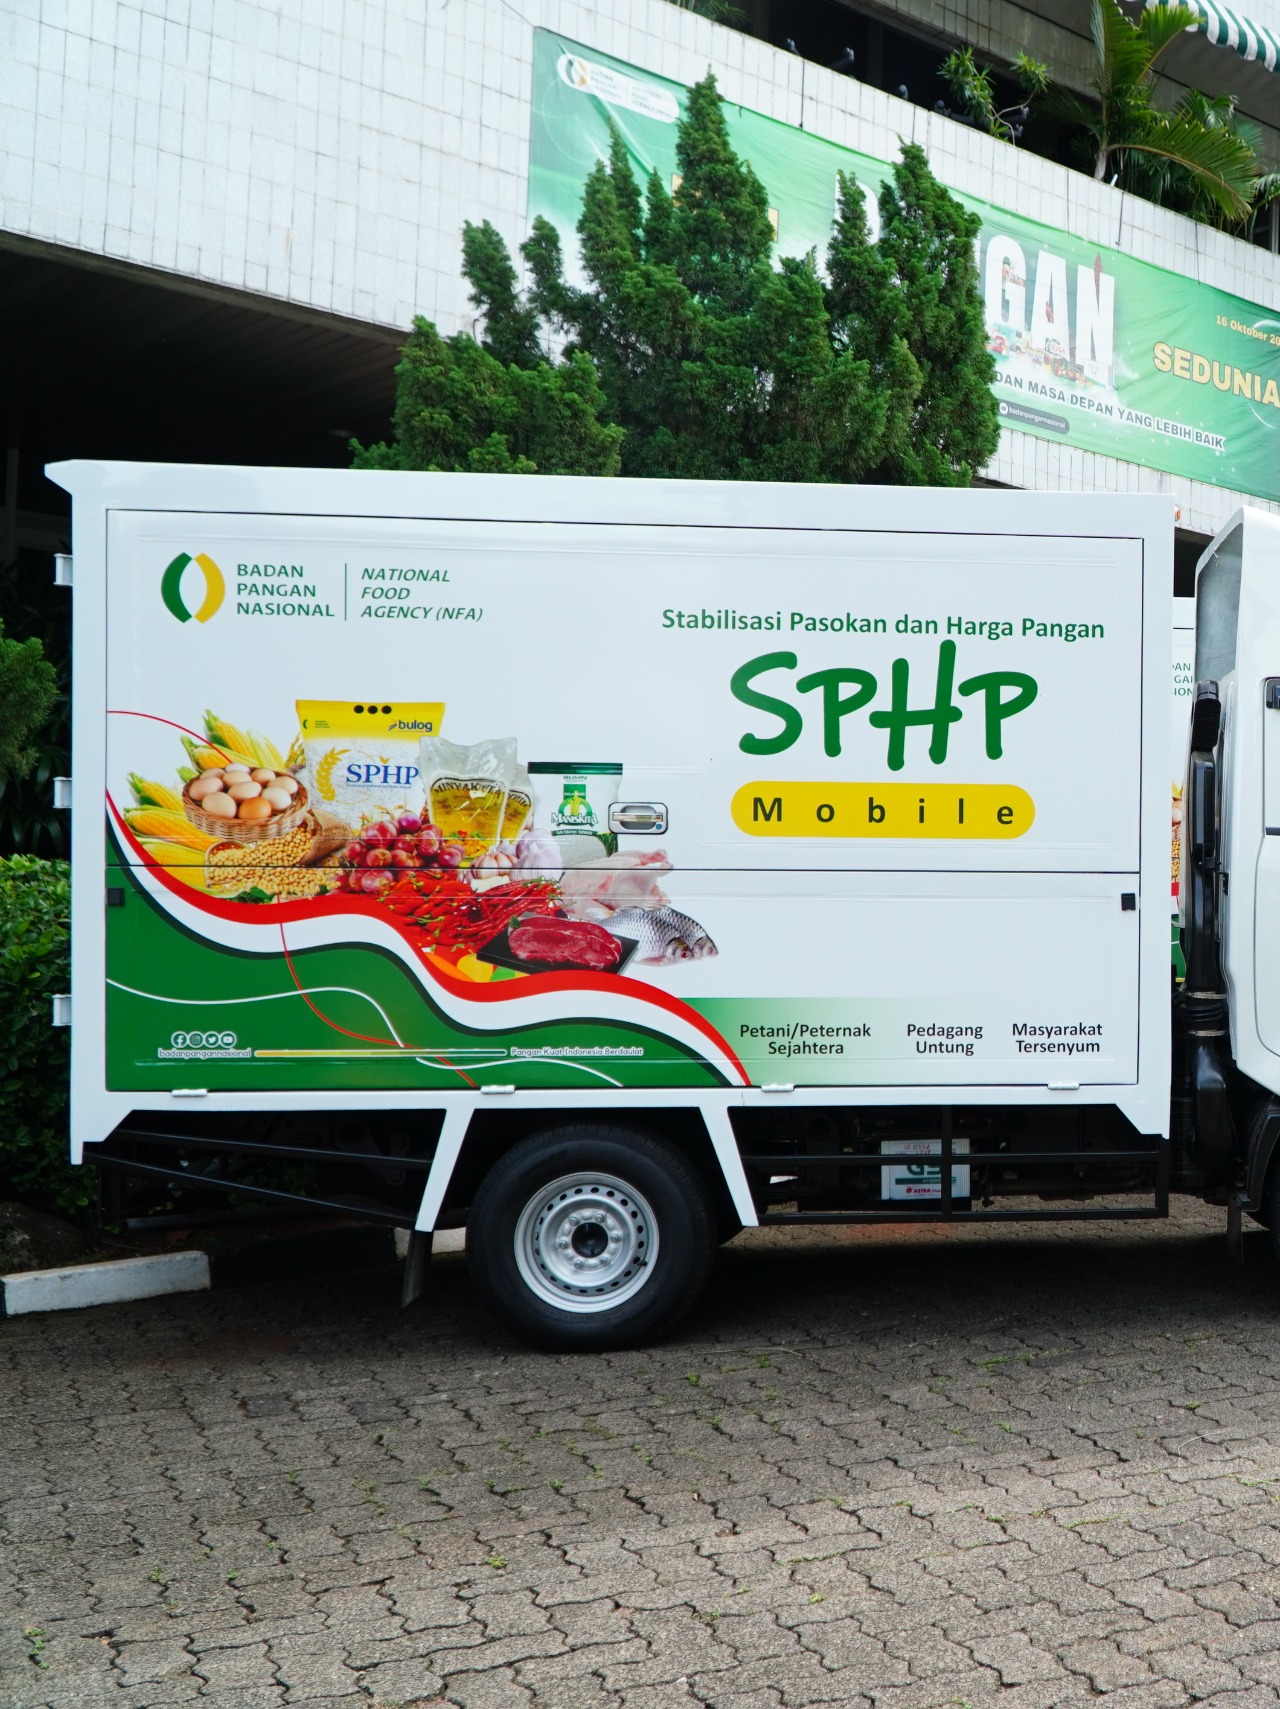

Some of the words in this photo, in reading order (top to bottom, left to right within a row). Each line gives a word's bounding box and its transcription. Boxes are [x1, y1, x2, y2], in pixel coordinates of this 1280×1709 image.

[1216, 315, 1228, 327] 16
[1230, 320, 1267, 341] Oktober
[1153, 341, 1280, 408] SEDUNIA
[994, 371, 1023, 389] DAN
[1028, 383, 1065, 403] MASA
[1070, 393, 1113, 416] DEPAN
[1117, 407, 1152, 428] YANG
[1156, 418, 1191, 440] LEBIH
[1195, 431, 1223, 449] BAIK
[1008, 406, 1066, 429] badanpangannasional
[237, 563, 304, 578] BADAN
[361, 568, 451, 583] NATIONAL
[237, 583, 317, 598] PANGAN
[361, 587, 411, 601] FOOD
[237, 602, 335, 618] NASIONAL
[360, 606, 433, 620] AGENCY
[435, 607, 483, 622] (NFA)
[662, 608, 781, 631] Stabilisasi
[790, 612, 887, 633] Pasokan
[895, 614, 938, 635] dan
[947, 616, 1014, 641] Harga
[1022, 618, 1105, 642] Pangan
[730, 639, 1038, 772] SPHP
[398, 719, 433, 733] bulog
[346, 763, 419, 785] SPHP
[752, 797, 1014, 825] Mobile
[740, 1023, 871, 1040] Petani/Peternak
[907, 1023, 983, 1040] Pedagang
[1012, 1022, 1103, 1038] Masyarakat
[158, 1048, 251, 1059] badanpangannasional
[511, 1048, 541, 1057] Pangan
[564, 1048, 602, 1056] Indonesia
[604, 1048, 643, 1056] Berdaulat
[768, 1040, 844, 1056] Sejahtera
[916, 1040, 974, 1056] Untung
[1016, 1040, 1100, 1055] Tersenyum
